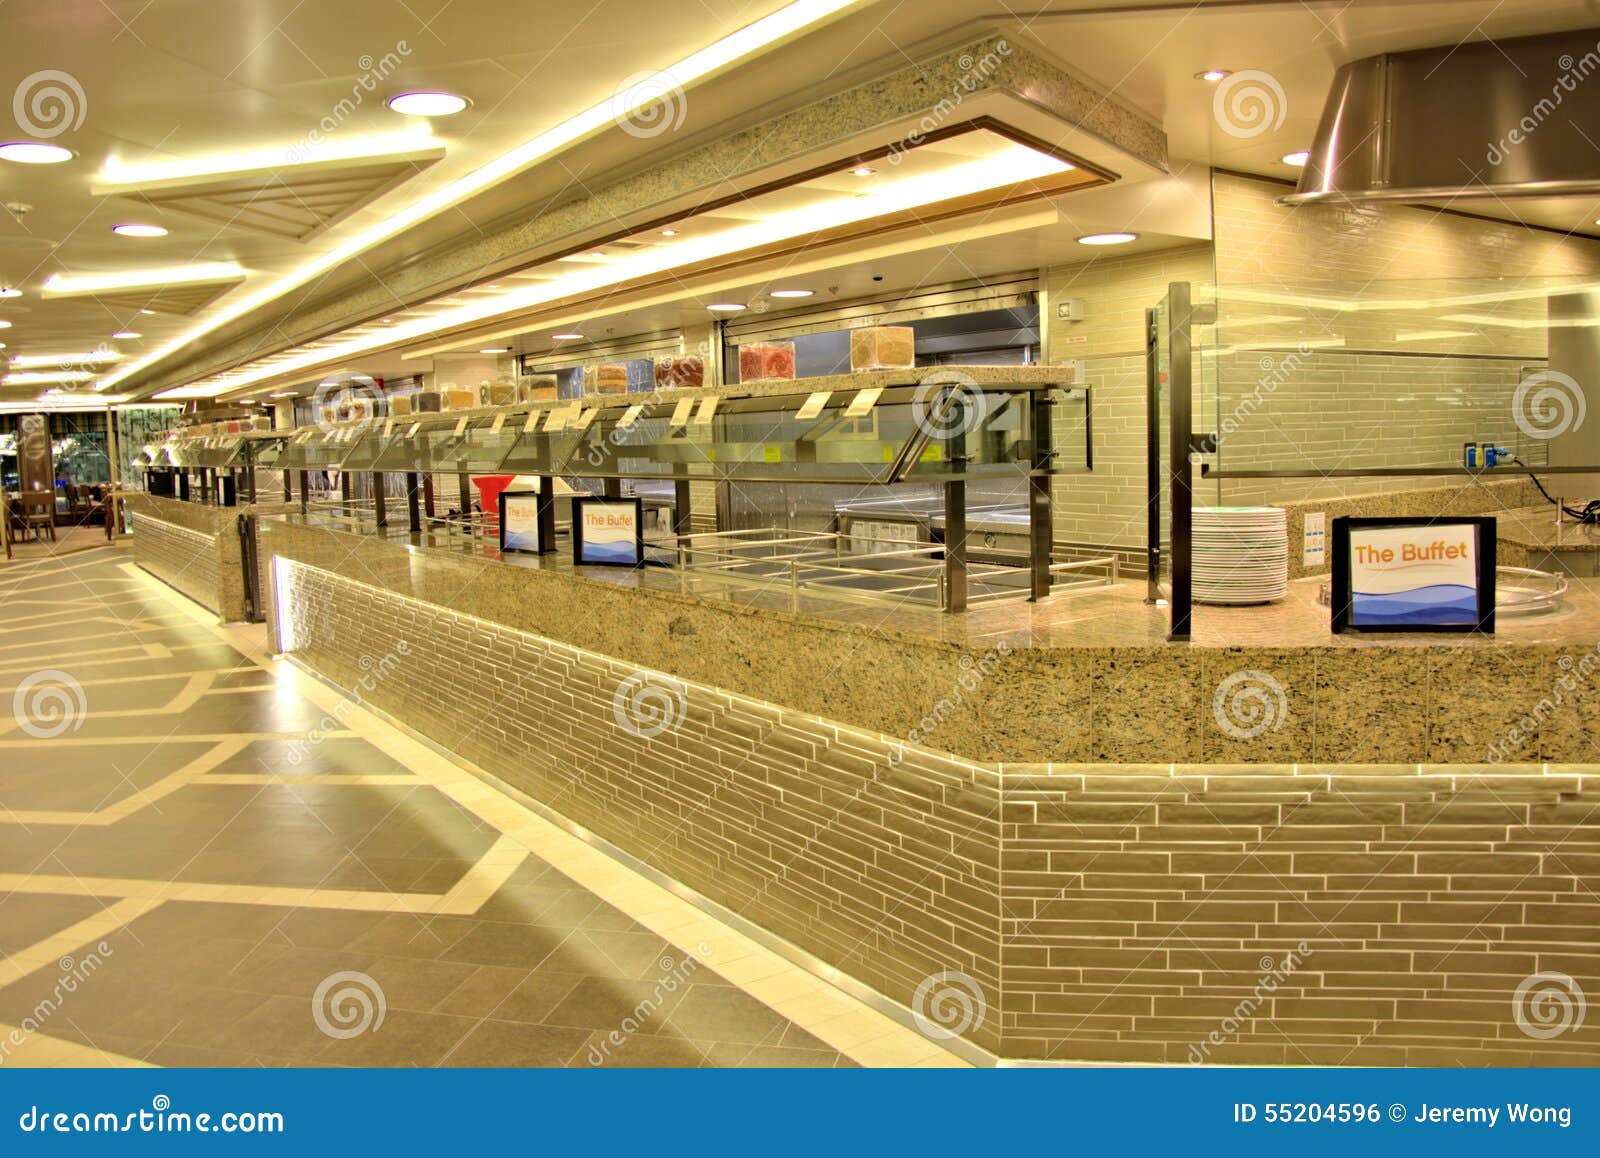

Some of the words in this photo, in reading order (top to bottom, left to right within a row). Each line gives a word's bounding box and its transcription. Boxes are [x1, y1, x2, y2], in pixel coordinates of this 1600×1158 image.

[585, 513, 604, 526] The
[1355, 544, 1394, 564] The
[1401, 541, 1467, 561] Buffet
